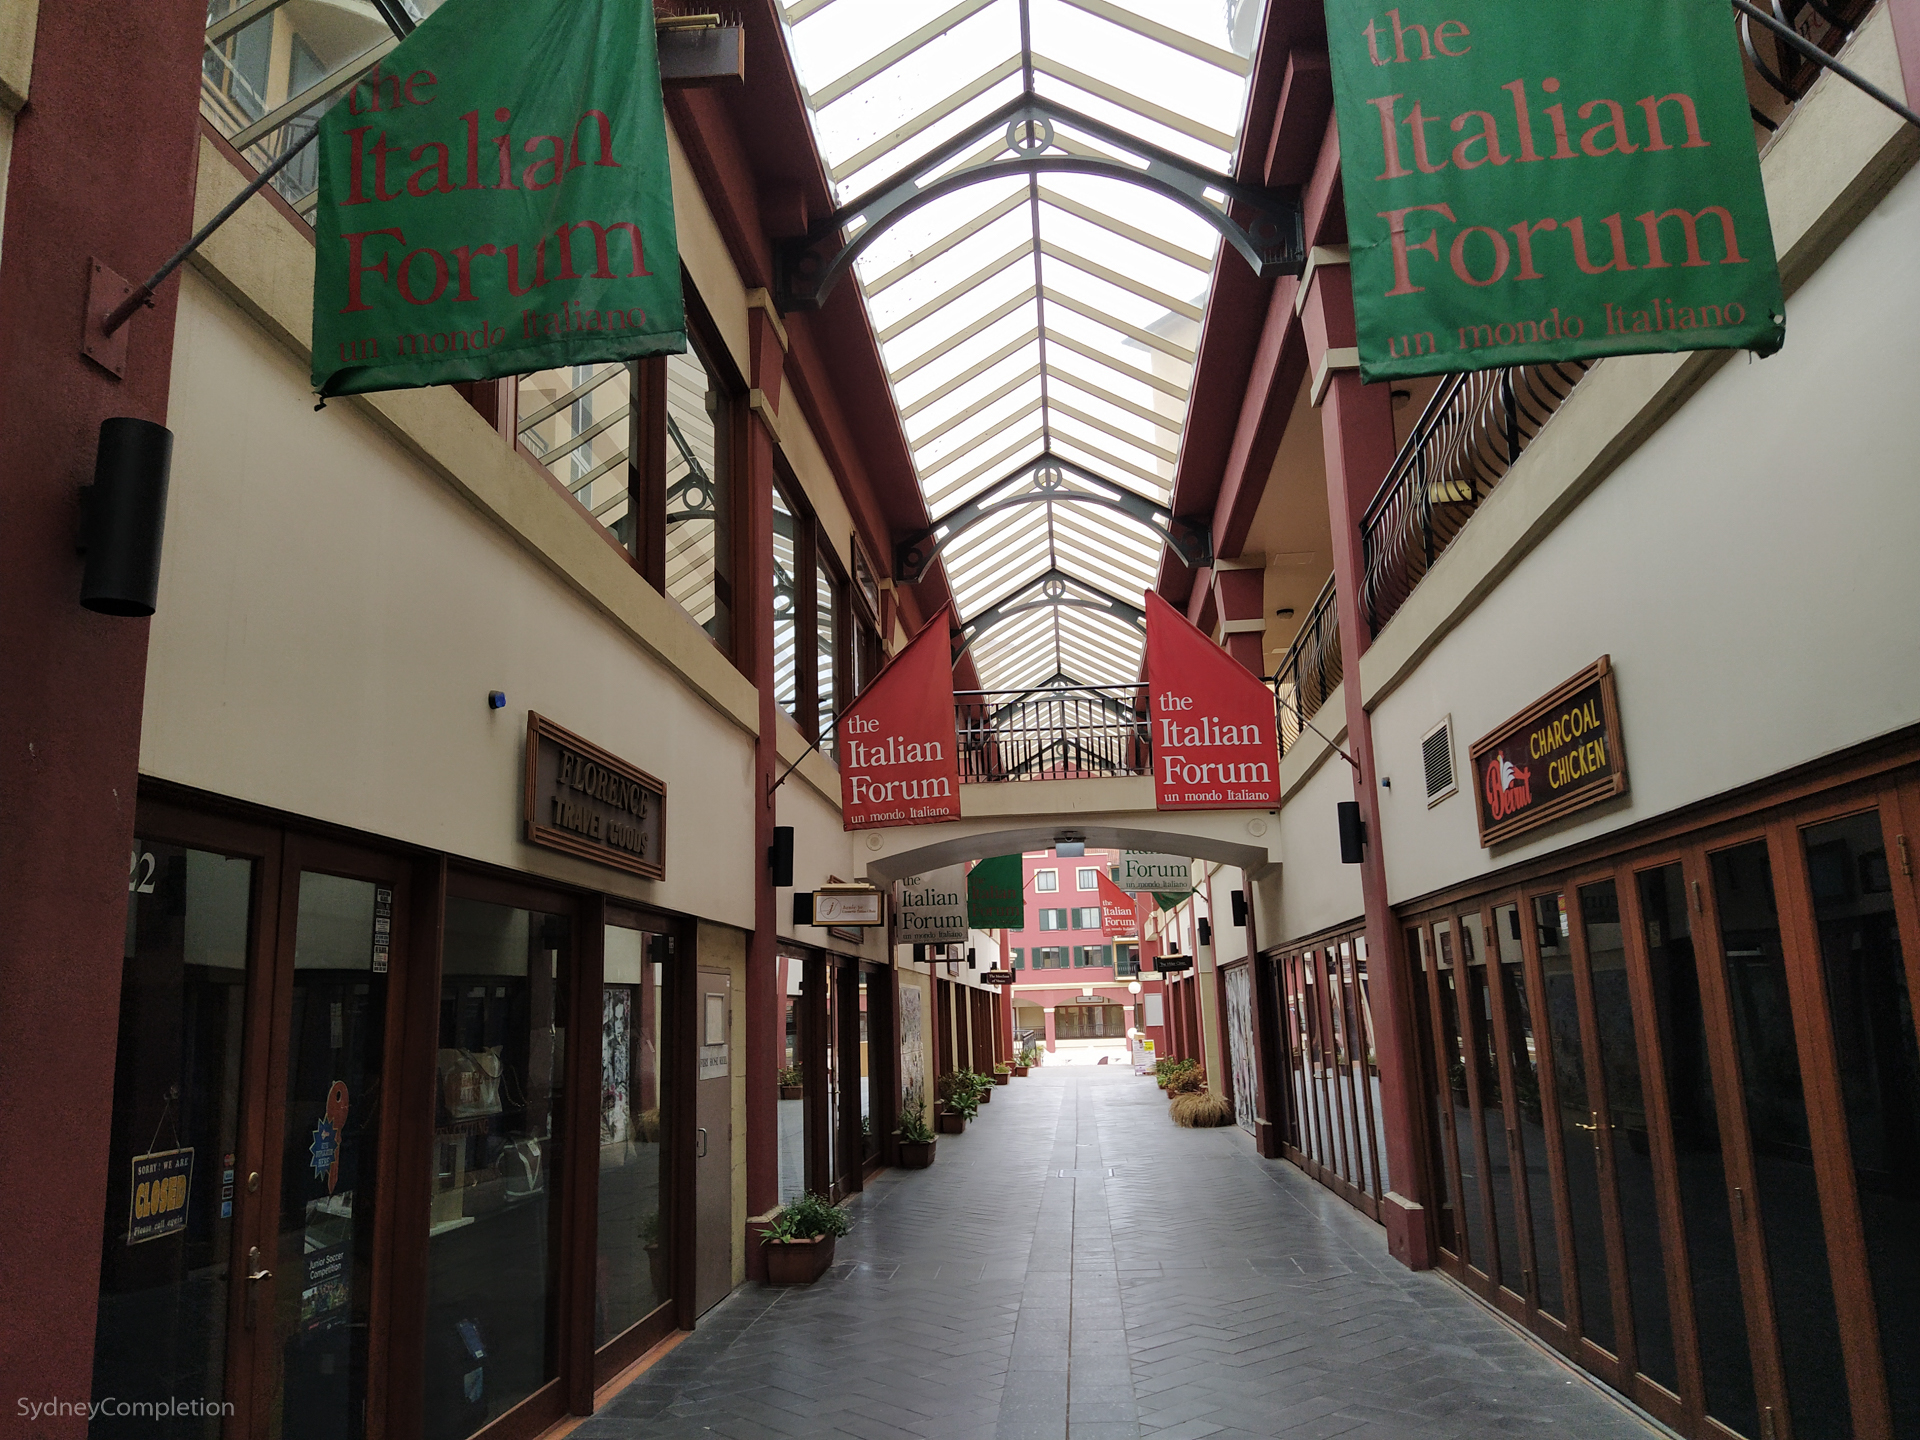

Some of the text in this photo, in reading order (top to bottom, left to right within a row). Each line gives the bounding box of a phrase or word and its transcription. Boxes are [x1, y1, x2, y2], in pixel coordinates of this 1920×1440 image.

[1362, 8, 1472, 67] the
[348, 62, 438, 115] the
[1366, 77, 1711, 181] Italian
[339, 107, 622, 207] Italian
[1376, 202, 1749, 297] Forum
[339, 219, 653, 314] Forum
[339, 300, 646, 363] un mondo Italiano
[1387, 298, 1746, 359] un mondo Italiano
[1159, 691, 1193, 711] the
[847, 714, 880, 734] the
[1159, 716, 1262, 747] Italian
[1530, 699, 1600, 759] CHARCOAL
[847, 736, 944, 768] Italian
[1549, 737, 1606, 789] CHICKEN
[1162, 755, 1271, 785] Forum
[557, 750, 649, 819] FLORENCE
[849, 775, 951, 805] Forum
[1164, 789, 1269, 802] un mondo Italiano
[552, 796, 648, 854] TRAVEL GOODS
[850, 806, 949, 824] un mondo Italiano
[1125, 860, 1188, 878] Forum
[902, 876, 921, 886] the
[902, 888, 959, 907] Italian
[971, 885, 1017, 900] Italian
[1102, 899, 1113, 907] the
[902, 912, 964, 930] Forum
[972, 903, 1020, 918] Forum
[1103, 906, 1132, 916] Italian
[1104, 917, 1135, 927] Forum
[938, 931, 963, 939] Italiano
[163, 1160, 172, 1170] WE
[175, 1157, 189, 1168] ARE
[135, 1174, 187, 1219] CLOSED
[133, 1215, 183, 1237] Please call again
[309, 1252, 344, 1271] Junior Soccer
[310, 1263, 342, 1280] Competition
